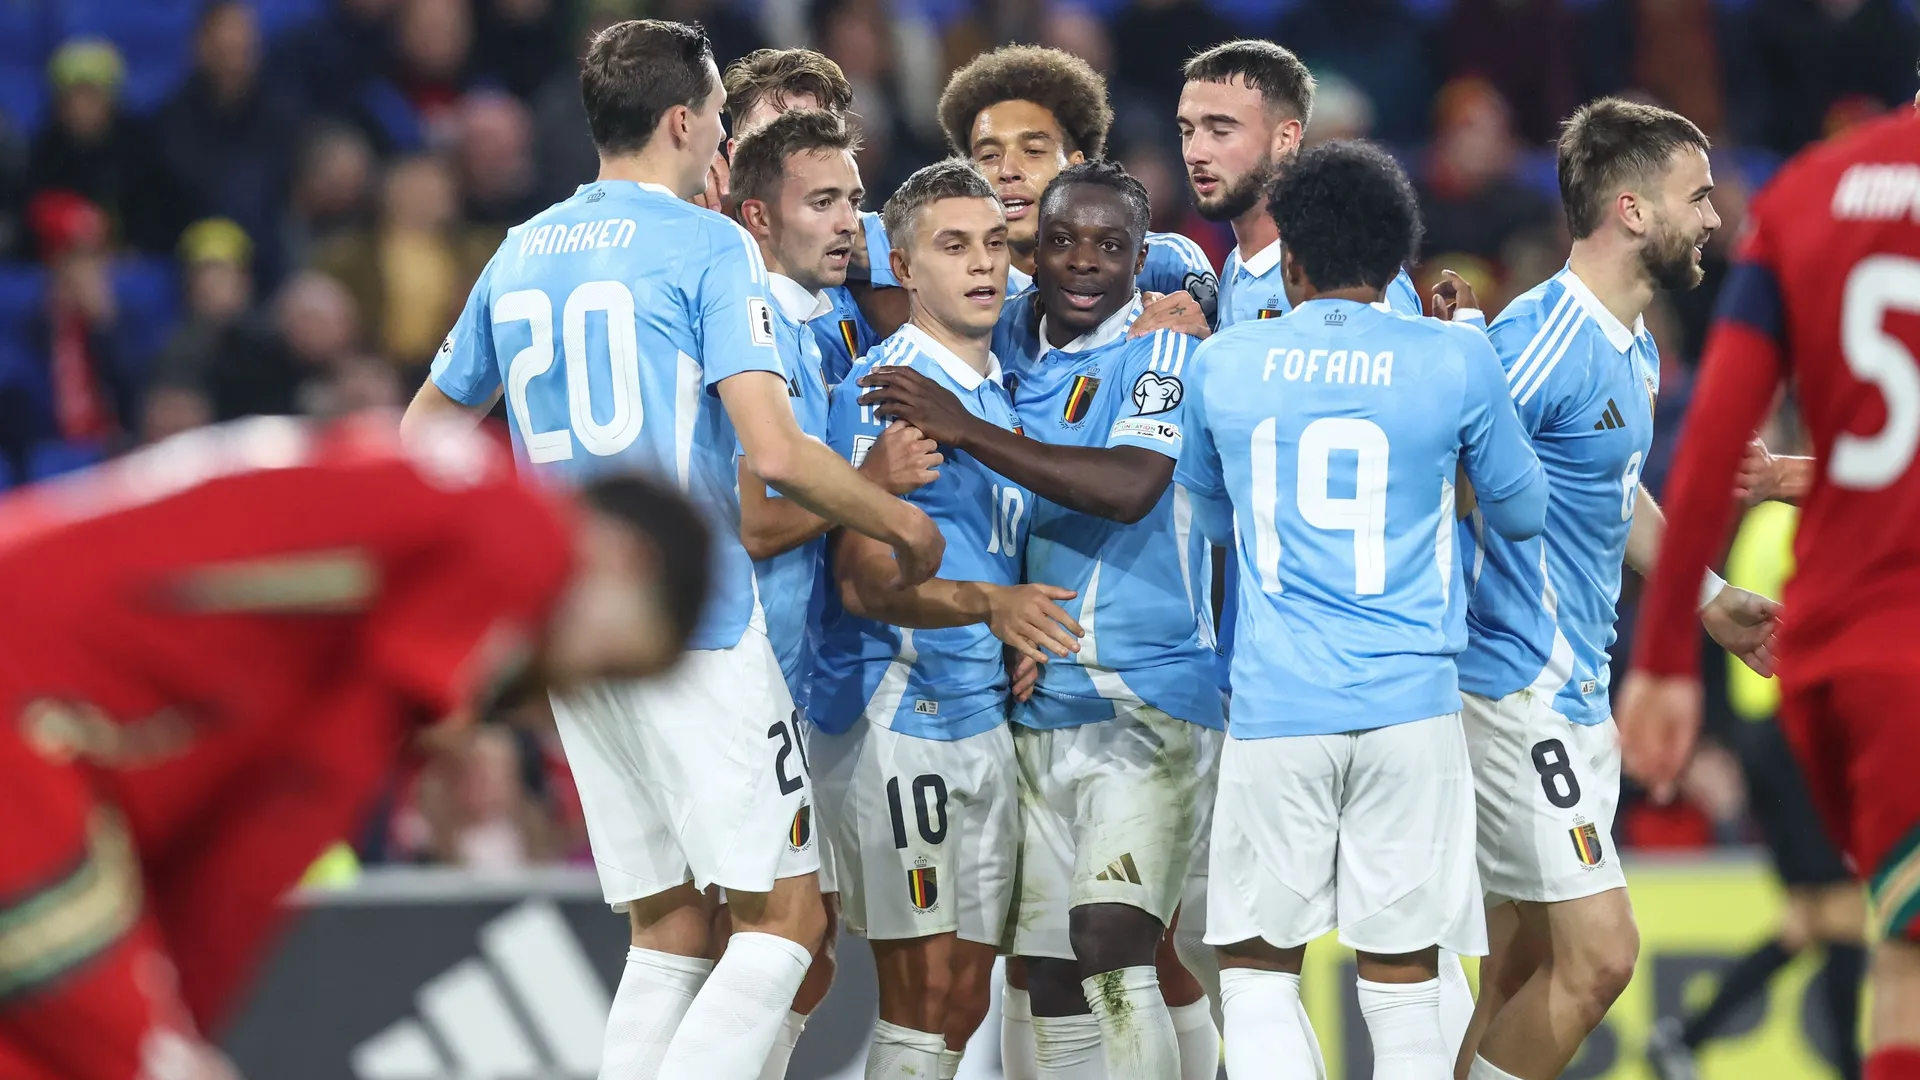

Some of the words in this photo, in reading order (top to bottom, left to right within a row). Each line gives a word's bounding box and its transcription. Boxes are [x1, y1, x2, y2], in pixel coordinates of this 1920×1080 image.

[519, 218, 637, 258] VANAKEN
[493, 280, 644, 464] 20
[1262, 348, 1394, 387] FOFANA
[1827, 255, 1920, 490] 5
[986, 483, 1024, 557] 10
[1251, 416, 1390, 595] 19
[1620, 451, 1643, 522] 8
[1531, 738, 1581, 808] 8
[886, 774, 948, 849] 10
